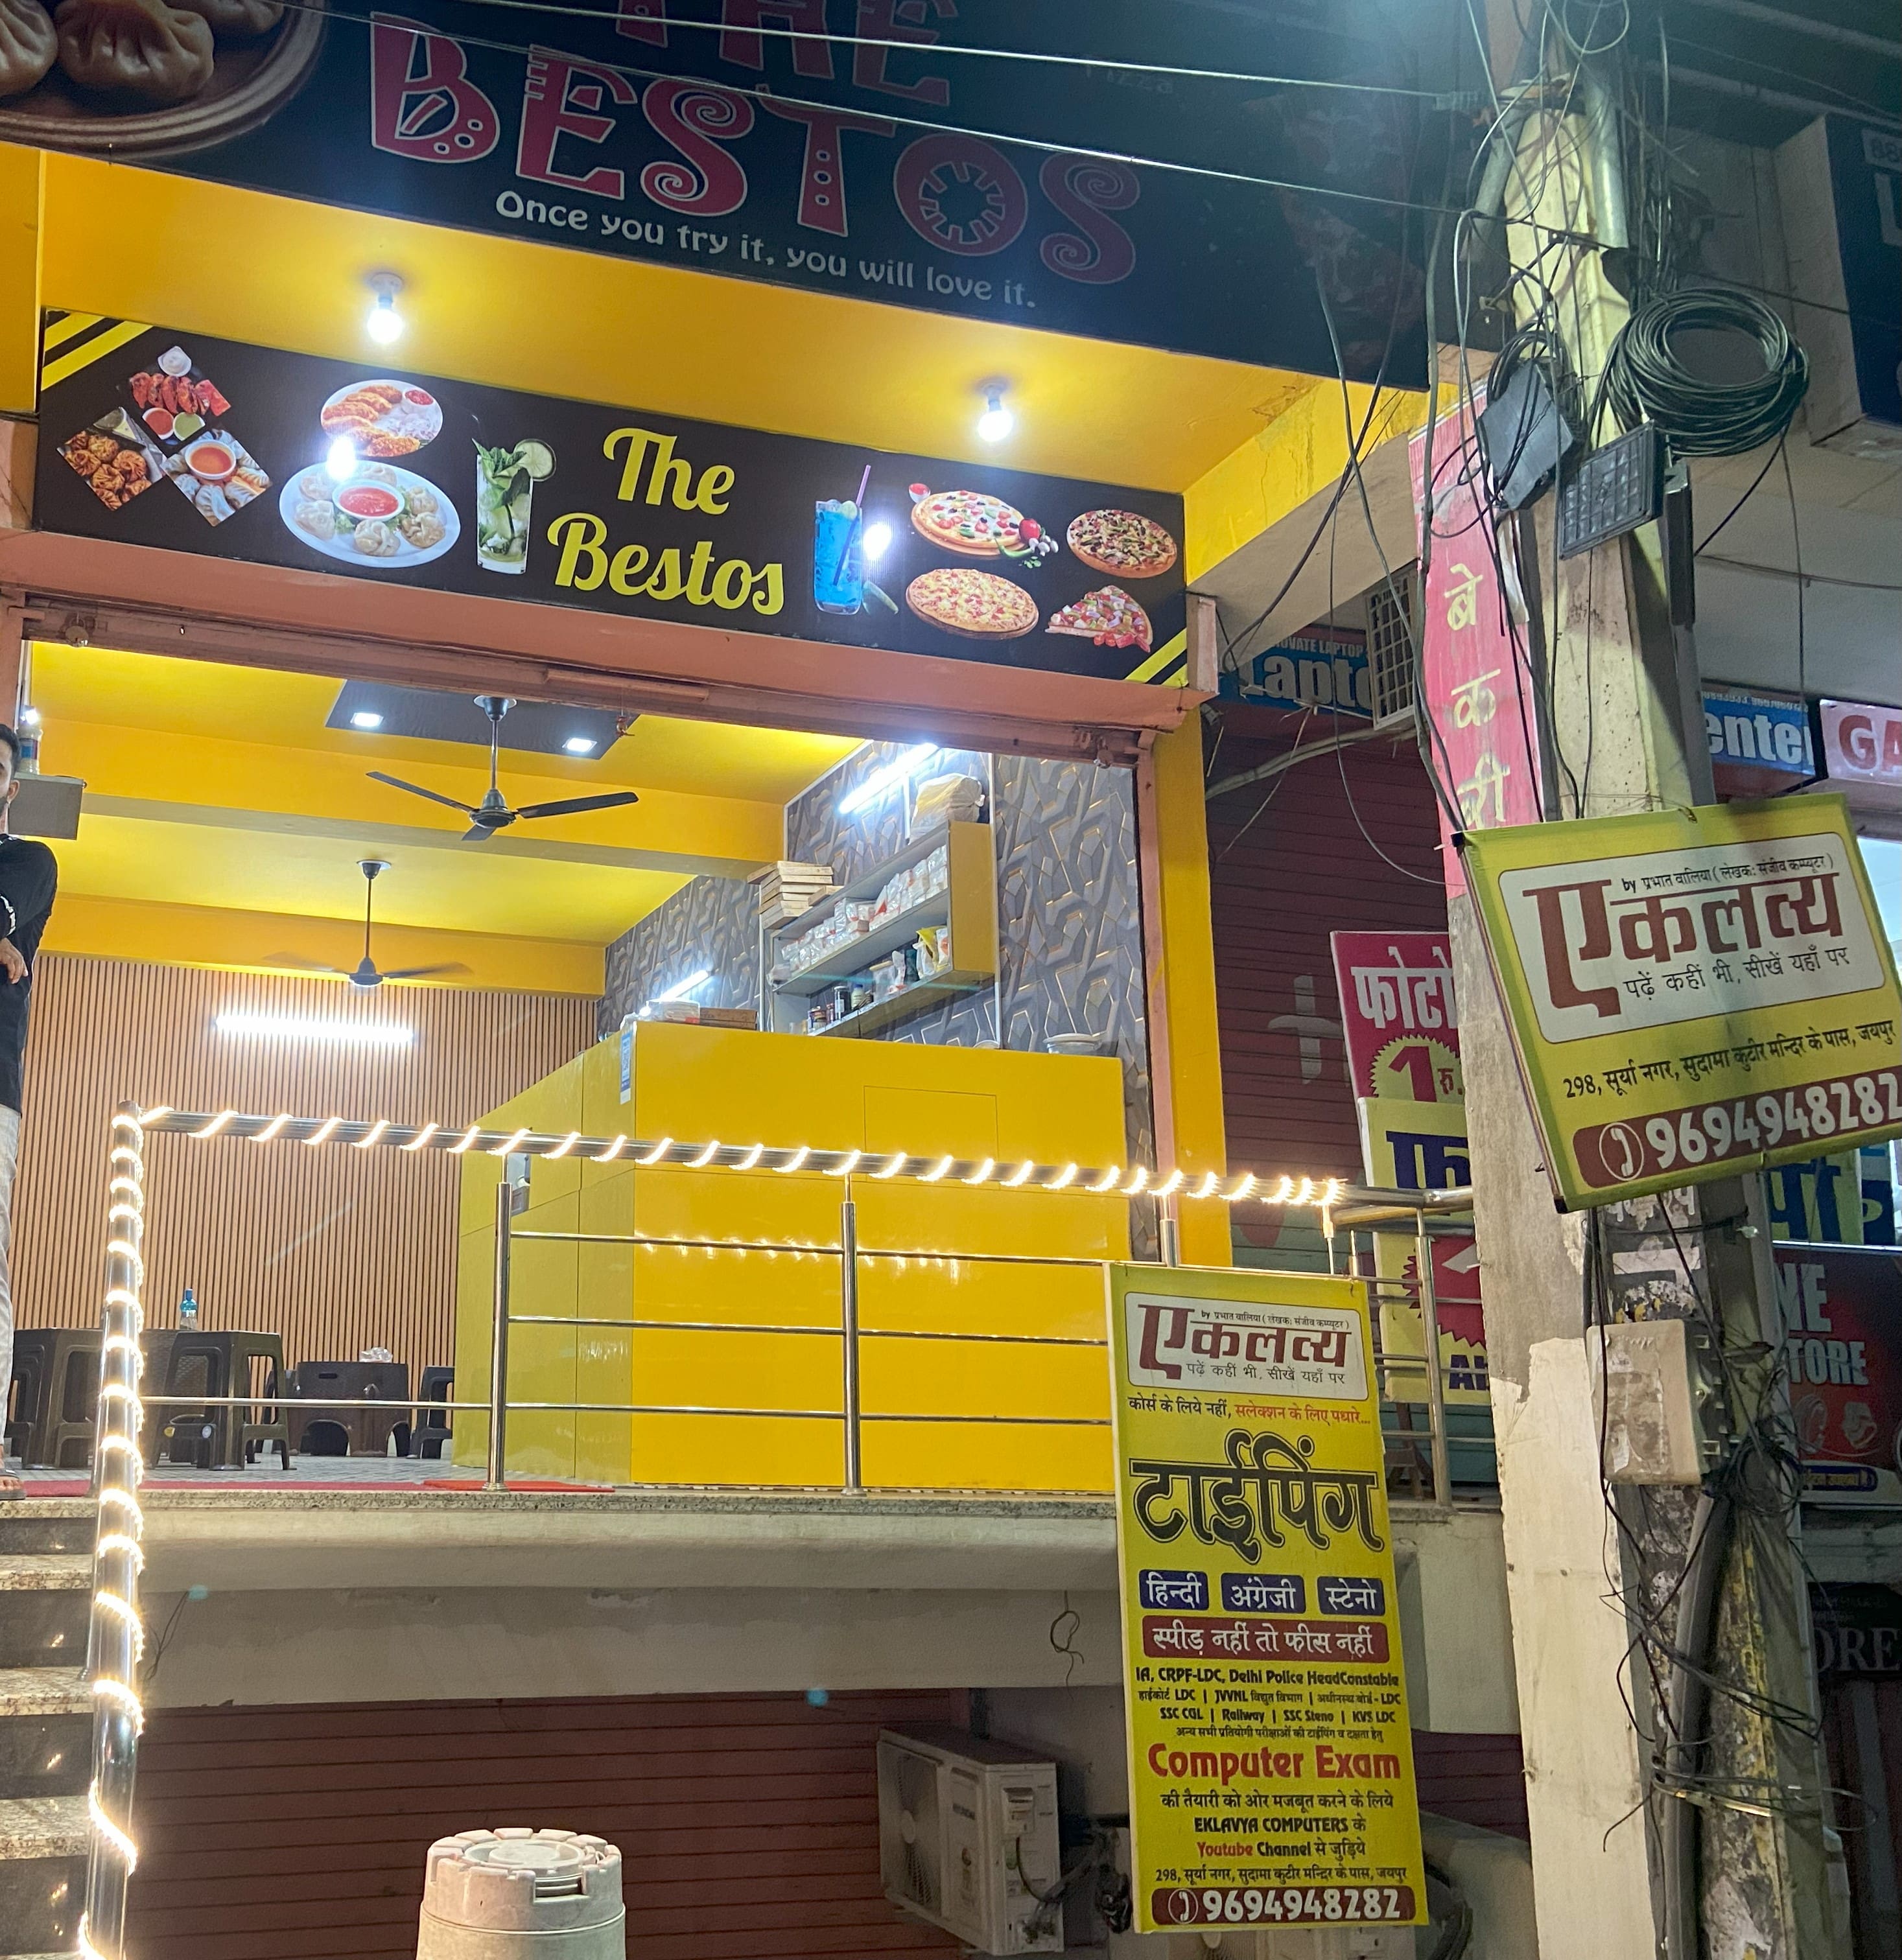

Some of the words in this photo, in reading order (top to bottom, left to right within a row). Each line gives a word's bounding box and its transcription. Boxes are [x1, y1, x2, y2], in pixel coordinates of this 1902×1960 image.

[370, 13, 1140, 284] BESTOS
[495, 190, 587, 231] Once
[600, 213, 663, 245] you
[677, 224, 728, 253] try
[740, 234, 775, 266] it,
[787, 246, 847, 277] you
[860, 260, 913, 288] will
[927, 266, 992, 301] love
[1004, 280, 1037, 309] it.
[603, 428, 735, 515] The
[547, 512, 784, 615] Bestos
[1623, 878, 1637, 893] by
[1662, 963, 1706, 991] कहीं
[1825, 946, 1850, 966] पर
[1563, 1075, 1602, 1099] 298,
[1680, 1049, 1730, 1082] सुदामा
[1805, 1027, 1822, 1049] के
[1855, 1020, 1896, 1045] जयपुर
[1645, 1073, 1902, 1169] 9694948282
[1201, 1310, 1210, 1319] by
[1212, 1362, 1236, 1377] कहीं
[1328, 1372, 1345, 1384] पर
[1127, 1394, 1156, 1413] कोर्स
[1160, 1395, 1174, 1413] के
[1175, 1396, 1201, 1415] लिये
[1287, 1403, 1303, 1419] के
[1304, 1404, 1331, 1426] लिए
[1129, 1428, 1385, 1565] टाईपिंग
[1146, 1571, 1202, 1607] हिन्दी
[1230, 1576, 1297, 1611] अंग्रेजी
[1324, 1578, 1378, 1611] स्टेनो
[1211, 1621, 1250, 1654] नहीं
[1255, 1623, 1280, 1652] तो
[1284, 1623, 1333, 1653] फीस
[1335, 1626, 1374, 1657] नहीं
[1229, 1669, 1262, 1683] Delhi
[1266, 1670, 1303, 1685] Police
[1175, 1689, 1195, 1701] LDC
[1381, 1693, 1401, 1705] LDC
[1160, 1707, 1179, 1720] SSC
[1222, 1709, 1265, 1723] Railway
[1283, 1709, 1302, 1721] SSC
[1305, 1710, 1334, 1722] Steno
[1376, 1711, 1396, 1723] LDC
[1148, 1743, 1303, 1786] Computer
[1315, 1745, 1401, 1779] Exam
[1160, 1789, 1180, 1808] की
[1182, 1788, 1219, 1808] तैयारी
[1222, 1789, 1241, 1808] को
[1271, 1794, 1314, 1814] मजबूत
[1317, 1790, 1348, 1808] करने
[1350, 1790, 1364, 1808] के
[1366, 1790, 1394, 1808] लिये
[1194, 1817, 1258, 1834] EKLAVYA
[1263, 1818, 1348, 1834] COMPUTERS
[1352, 1812, 1367, 1832] के
[1197, 1842, 1254, 1858] Youtube
[1257, 1841, 1311, 1857] Channel
[1313, 1837, 1326, 1856] से
[1156, 1869, 1180, 1882] 298,
[1237, 1869, 1272, 1884] सुदामा
[1273, 1864, 1300, 1884] कुटीर
[1335, 1863, 1348, 1878] के
[1376, 1867, 1407, 1883] जयपुर
[1203, 1888, 1400, 1922] 9694948282
